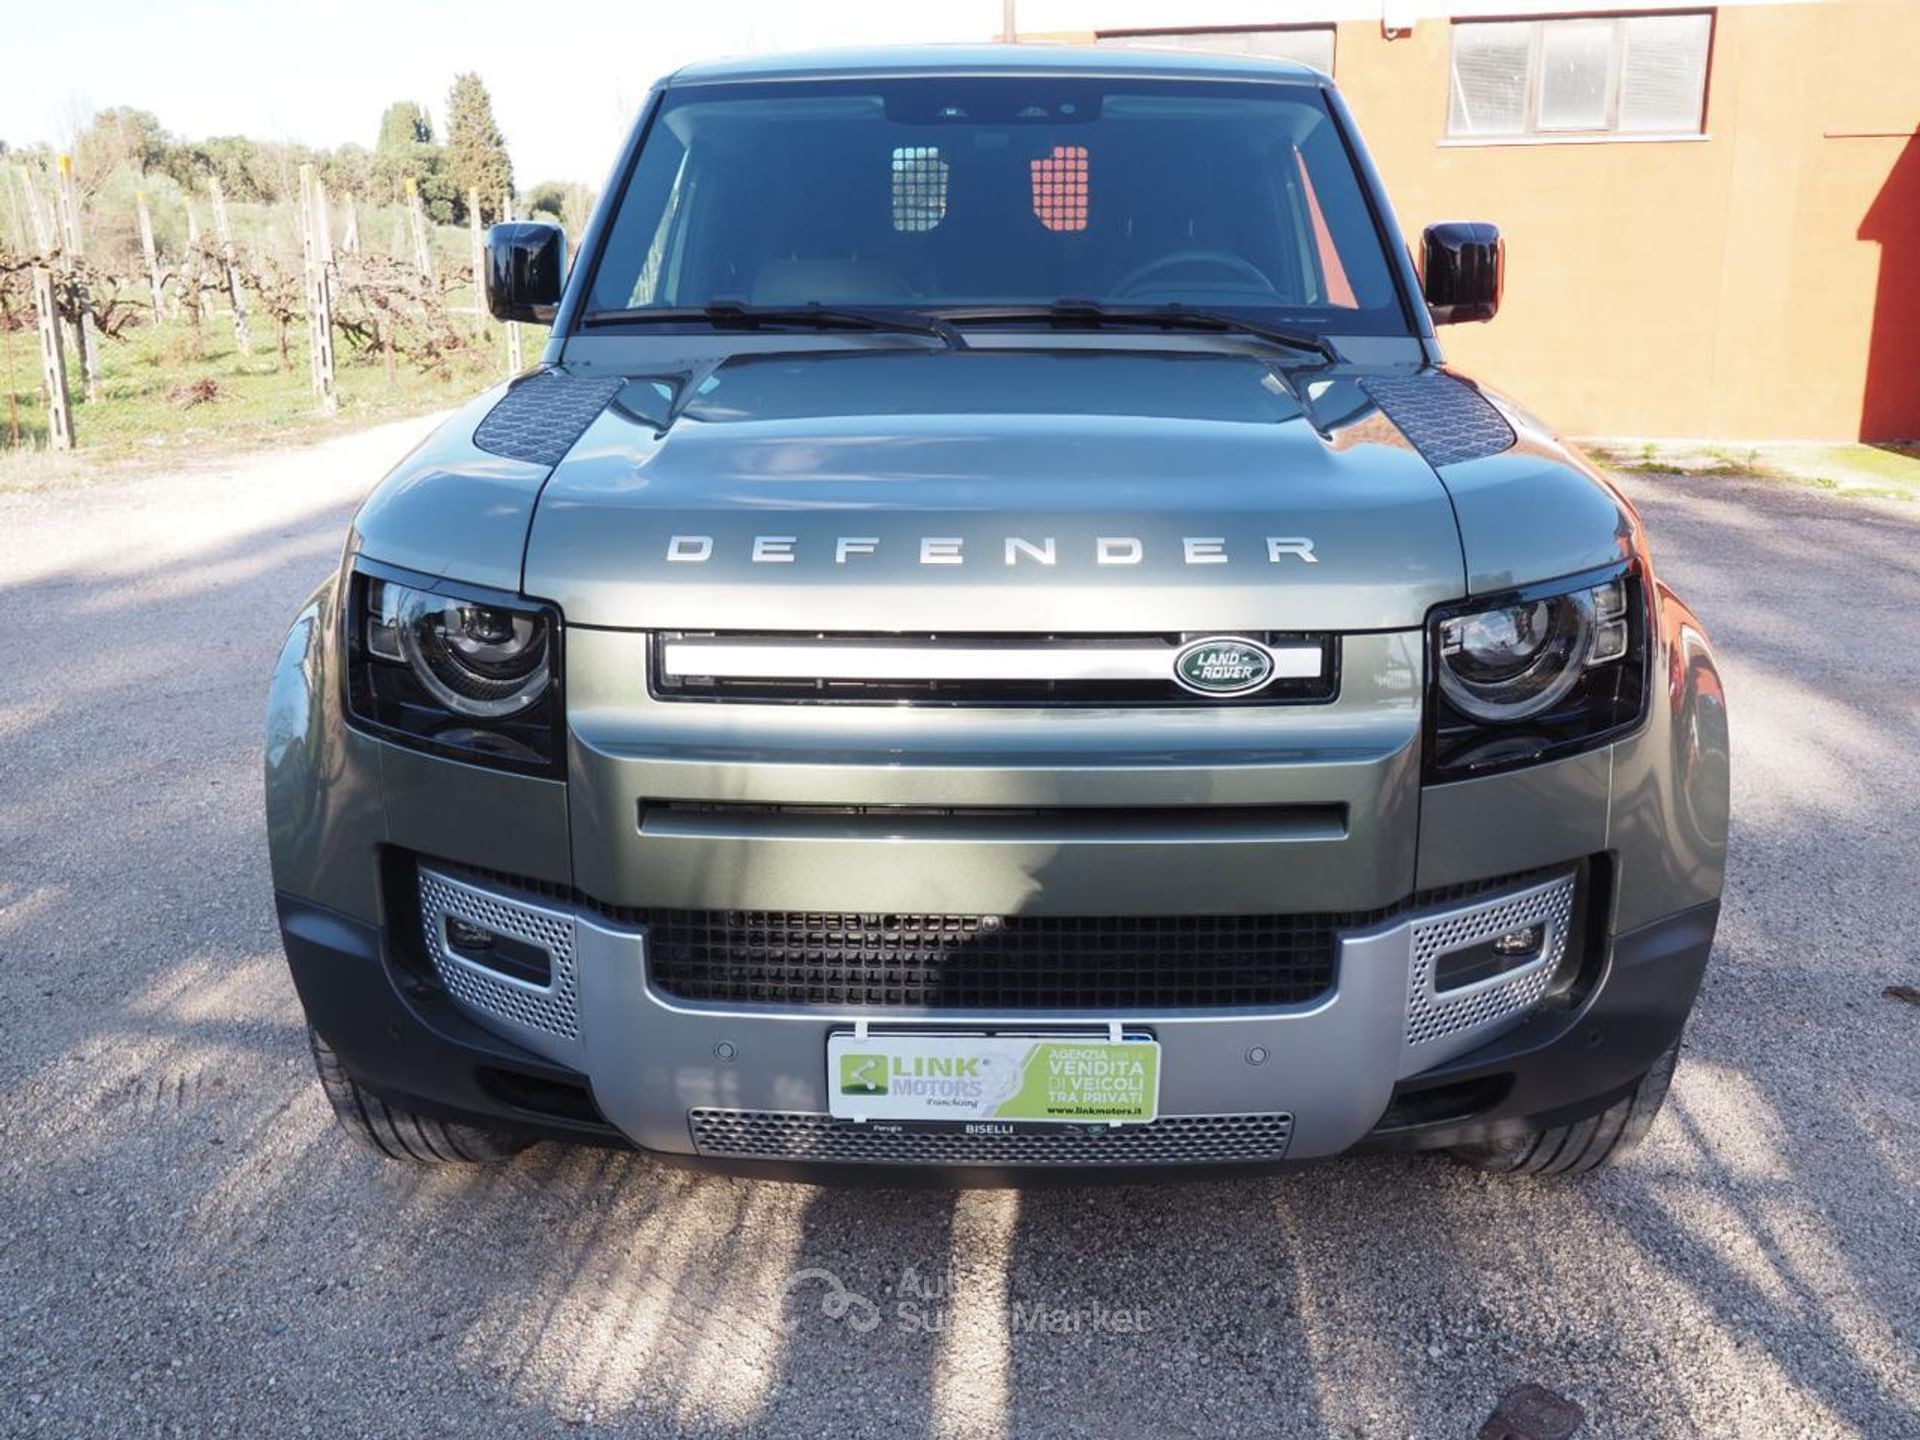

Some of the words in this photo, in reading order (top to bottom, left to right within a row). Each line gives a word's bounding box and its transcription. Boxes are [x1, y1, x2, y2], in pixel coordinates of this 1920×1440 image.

[666, 535, 1319, 565] DEFENDER
[1049, 1049, 1108, 1060] AGENZIA
[893, 1056, 979, 1077] LINK
[1049, 1059, 1145, 1076] VENDITA
[893, 1078, 983, 1097] MOTORS
[1049, 1077, 1066, 1090] DI
[1071, 1077, 1144, 1091] VEICOLI
[1050, 1091, 1078, 1103] TRA
[1084, 1091, 1143, 1105] PRIVATI
[1047, 1106, 1142, 1116] www.linkmotors.it
[965, 1123, 1014, 1135] BISELLI
